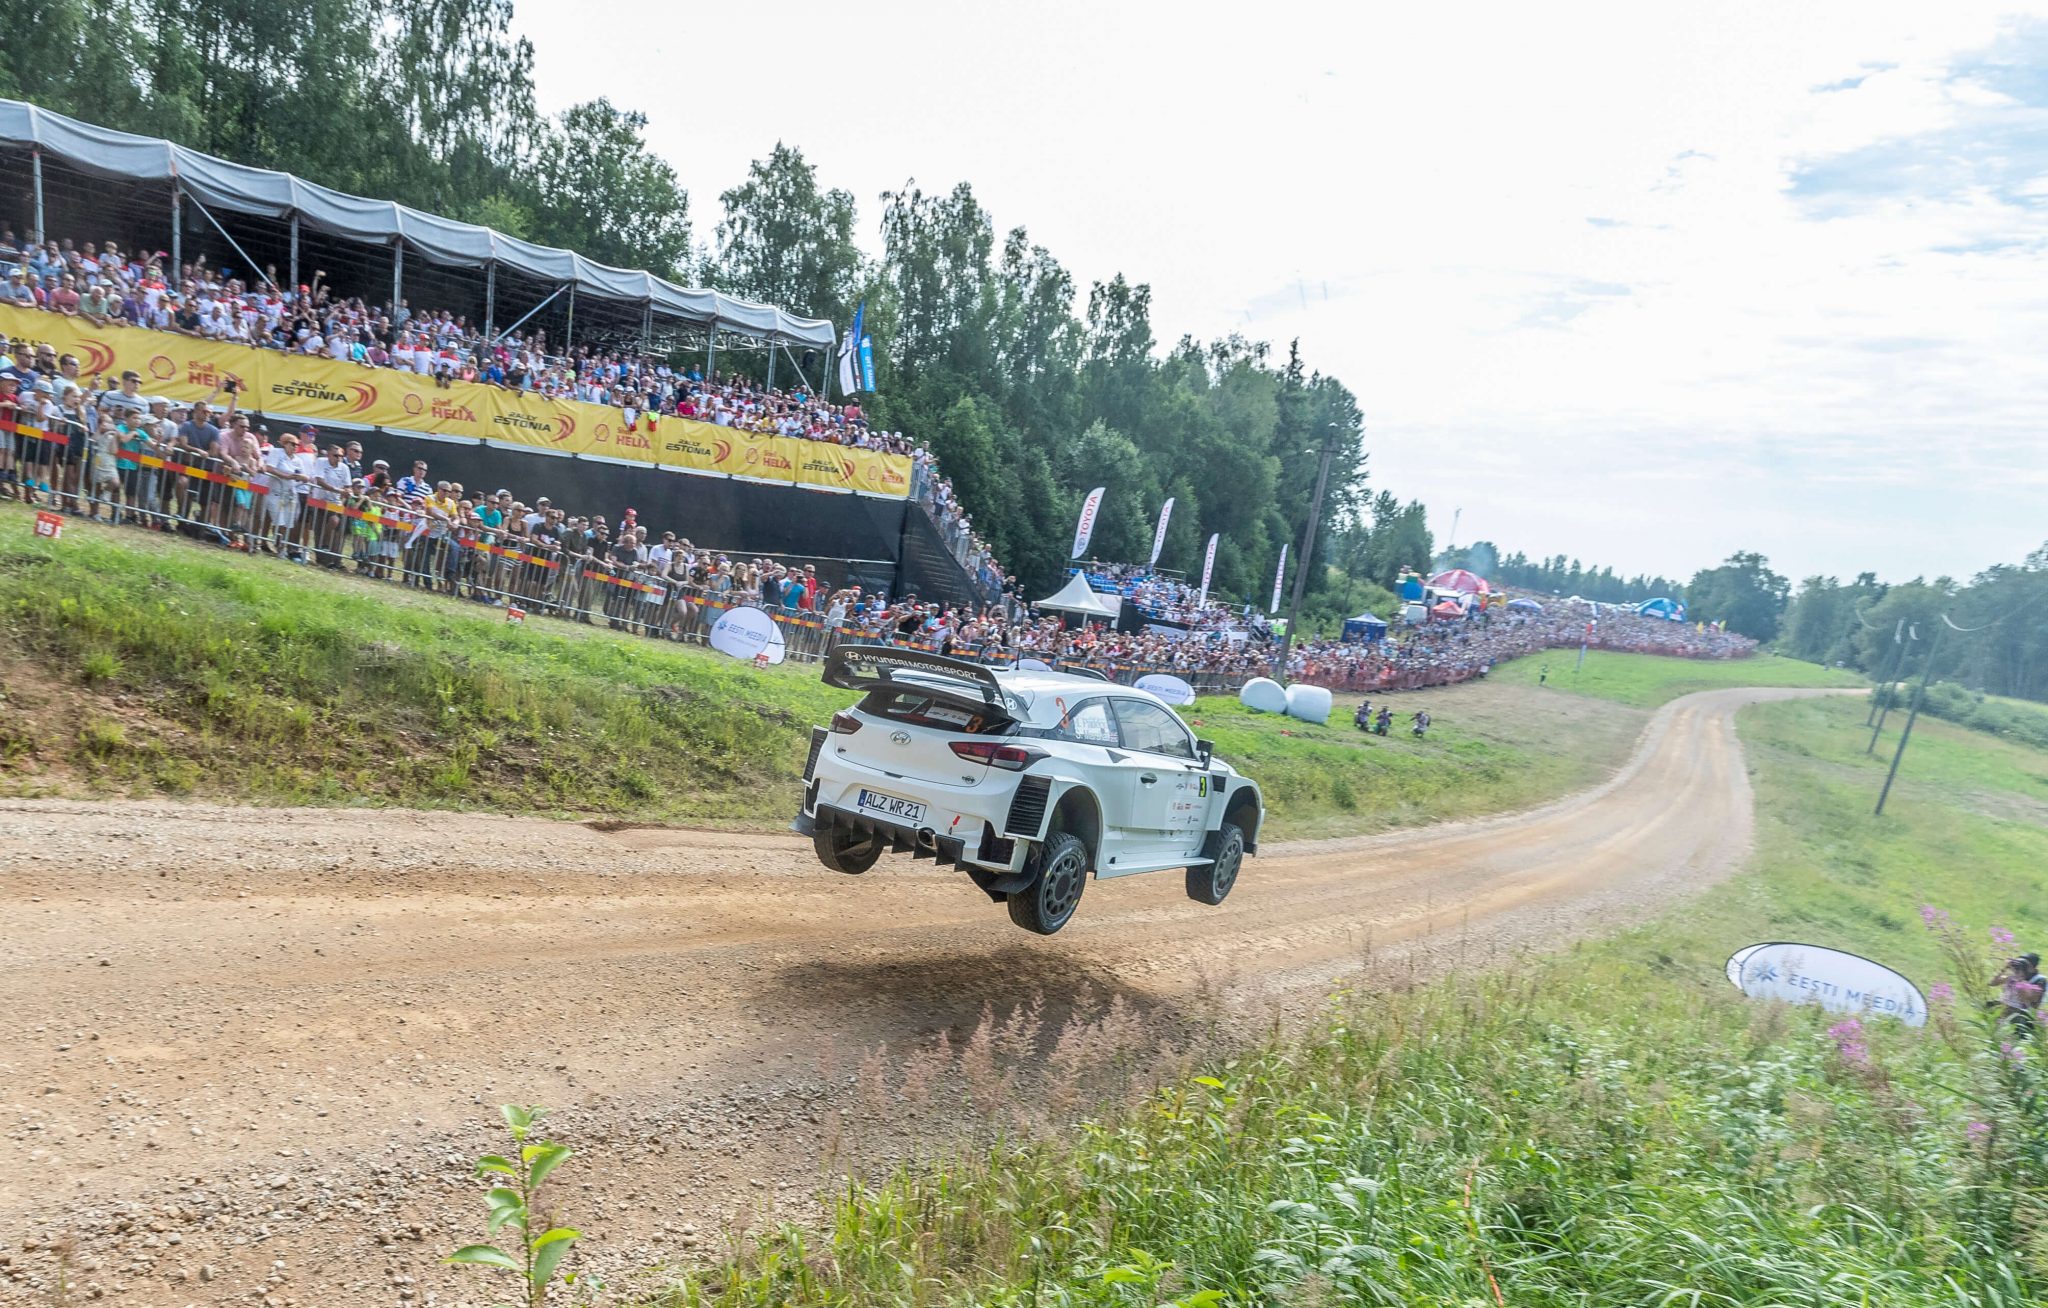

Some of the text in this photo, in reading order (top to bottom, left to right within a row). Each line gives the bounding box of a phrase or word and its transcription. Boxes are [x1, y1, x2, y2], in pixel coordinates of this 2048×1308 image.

[272, 384, 348, 403] ESTONIA
[291, 380, 329, 390] RALLY
[432, 405, 476, 422] HELIX
[508, 411, 538, 420] RALLY
[494, 415, 551, 432] ESTONIA
[616, 434, 651, 449] HELIX
[665, 442, 711, 456] ESTONIA
[763, 456, 792, 470] HELIX
[802, 464, 840, 474] ESTONIA
[1079, 495, 1098, 536] TOYOTA
[863, 654, 977, 680] HYUNDAI MOTORSPORT
[966, 715, 984, 733] 3
[865, 793, 888, 810] ALZ
[888, 799, 905, 815] WR
[904, 804, 920, 819] 21
[1787, 974, 1839, 997] EESTI
